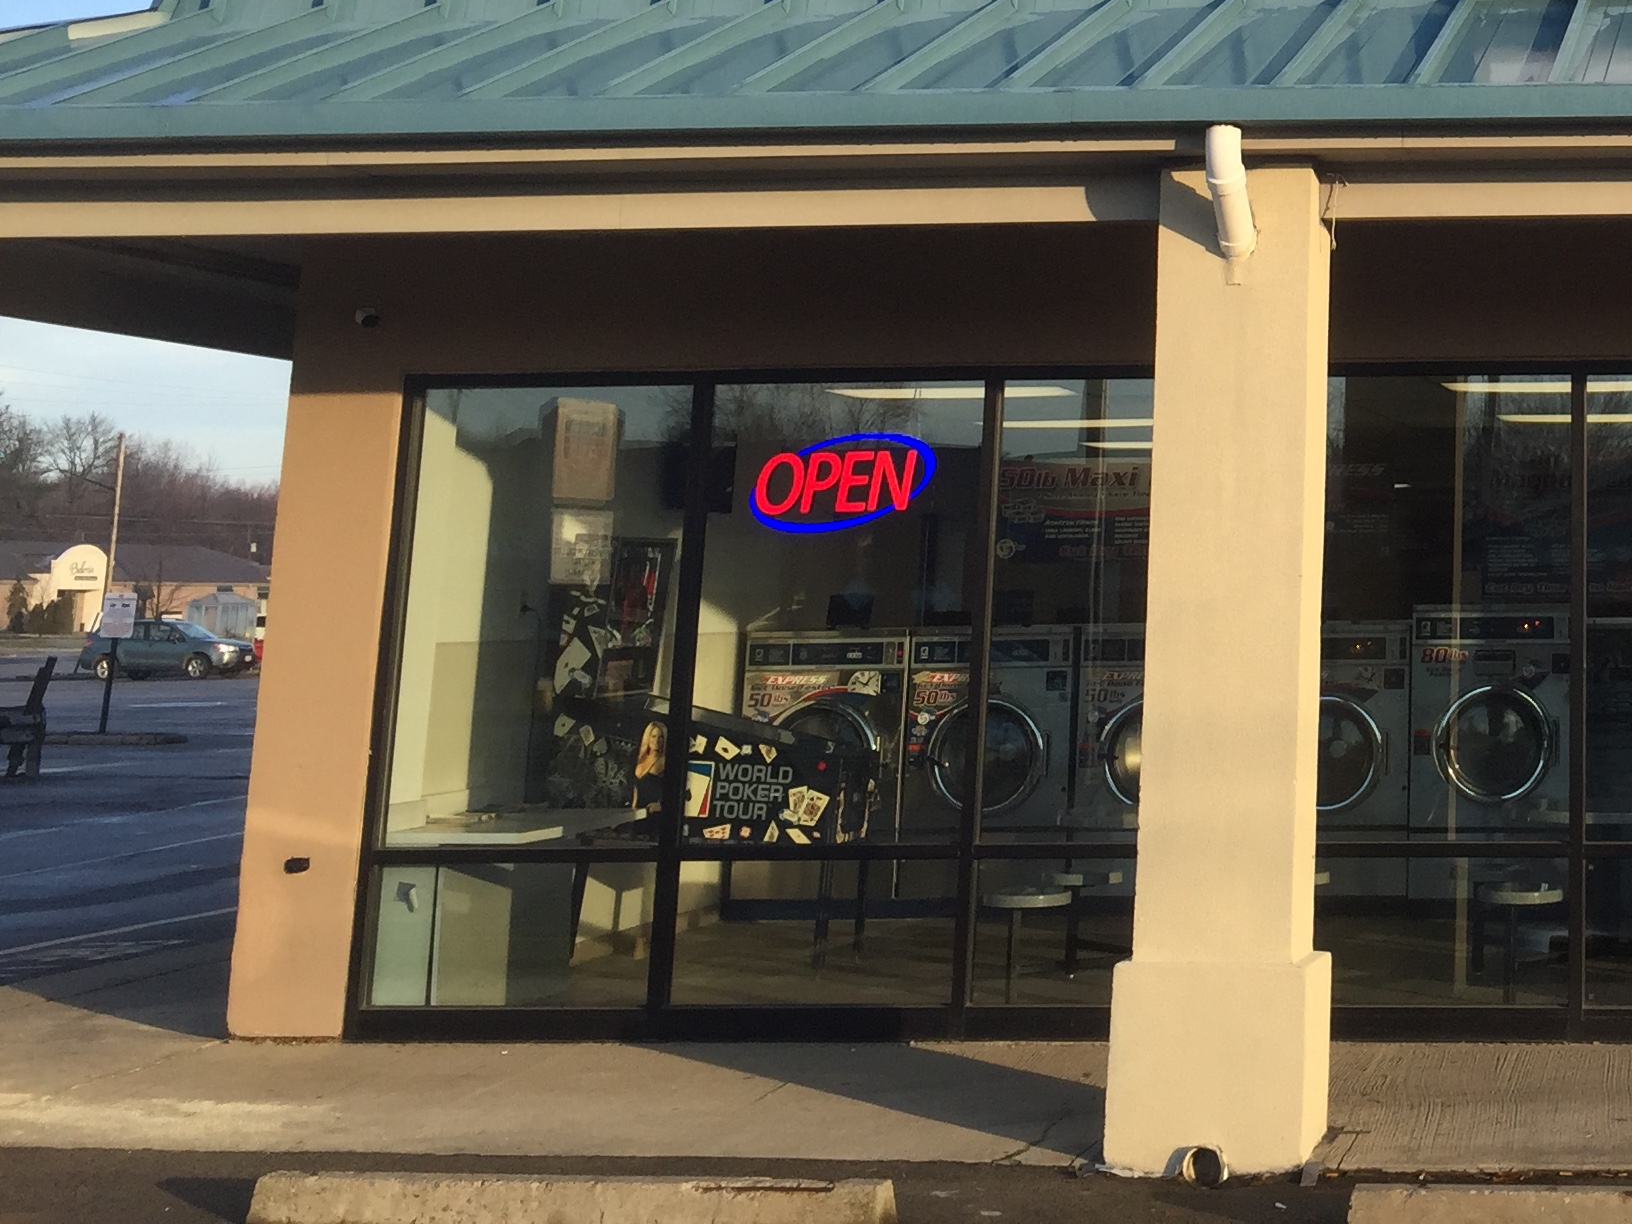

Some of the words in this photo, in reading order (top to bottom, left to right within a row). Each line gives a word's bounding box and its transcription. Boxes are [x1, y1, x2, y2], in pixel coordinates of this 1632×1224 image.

[755, 449, 918, 516] OPEN
[1063, 465, 1139, 488] Maxi
[766, 675, 831, 685] EXPRESS
[931, 673, 971, 682] EXPR
[748, 693, 773, 708] 50
[913, 690, 939, 706] 50
[1084, 688, 1109, 703] 50
[718, 763, 793, 784] WORLD
[715, 781, 785, 802] POKER
[713, 800, 767, 820] TOUR
